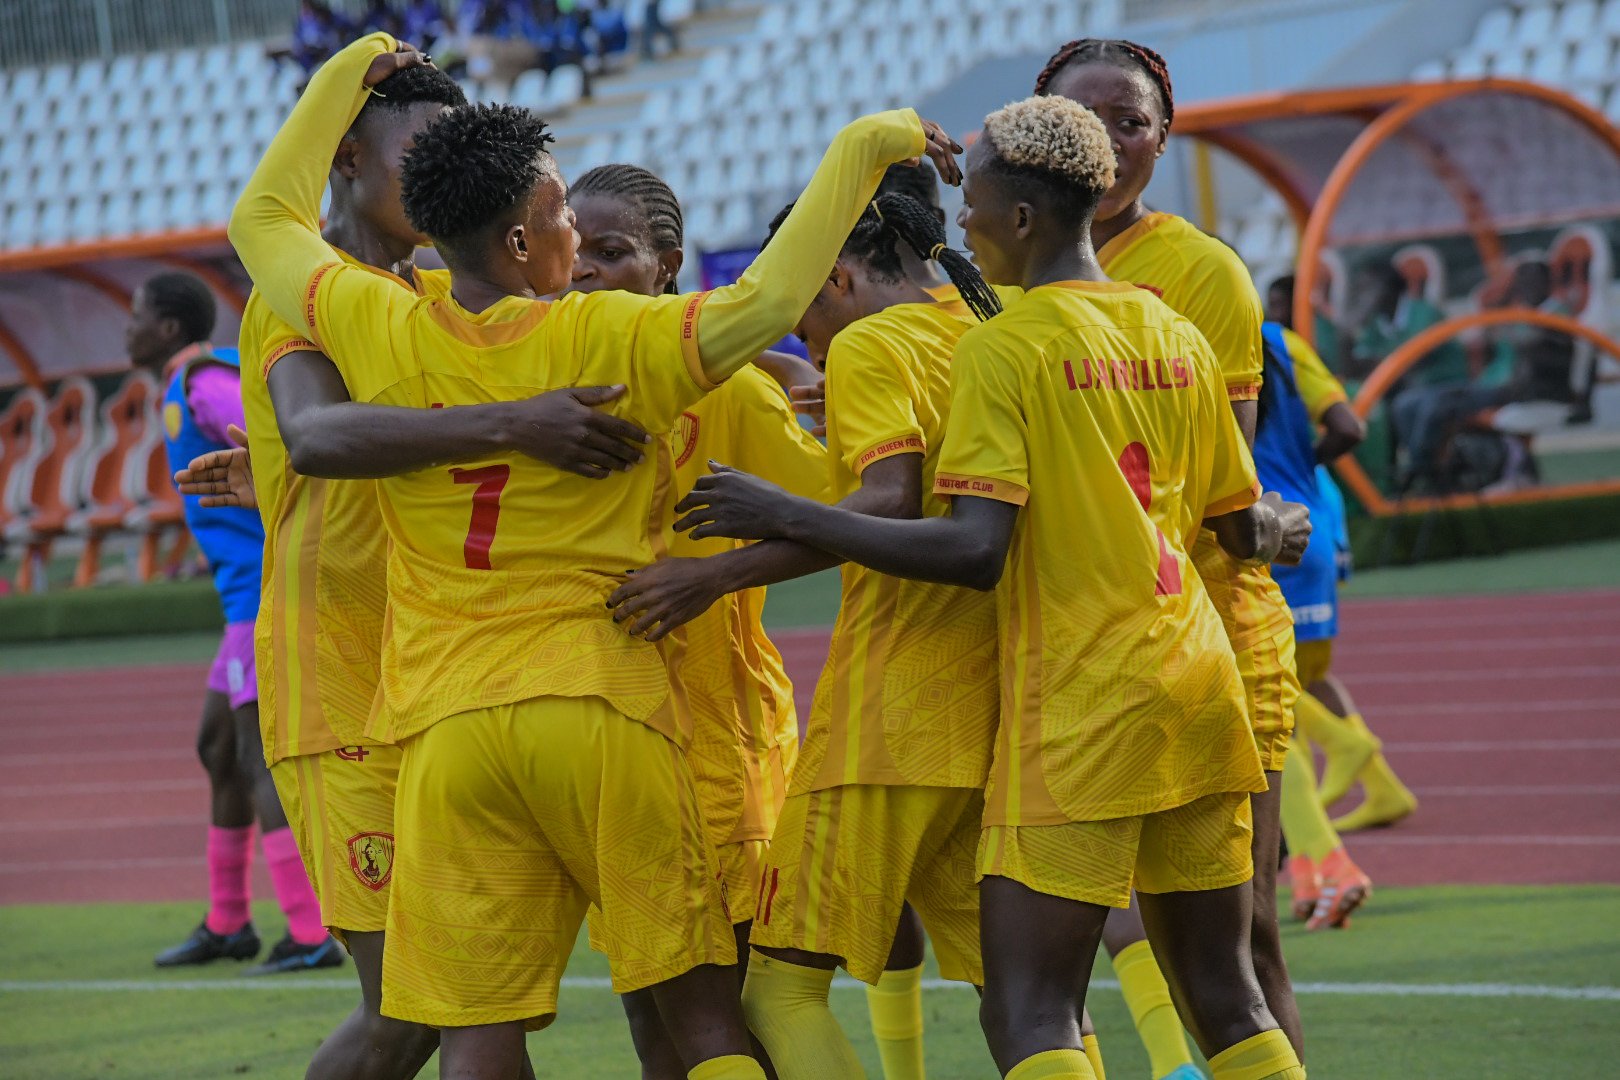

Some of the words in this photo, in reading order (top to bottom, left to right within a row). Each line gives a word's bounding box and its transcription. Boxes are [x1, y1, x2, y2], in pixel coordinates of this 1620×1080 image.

[307, 303, 316, 327] CLUB
[683, 321, 692, 339] EDO
[860, 450, 876, 464] EDO
[877, 440, 904, 455] QUEEN
[972, 481, 994, 493] CLUB
[448, 463, 510, 571] 7
